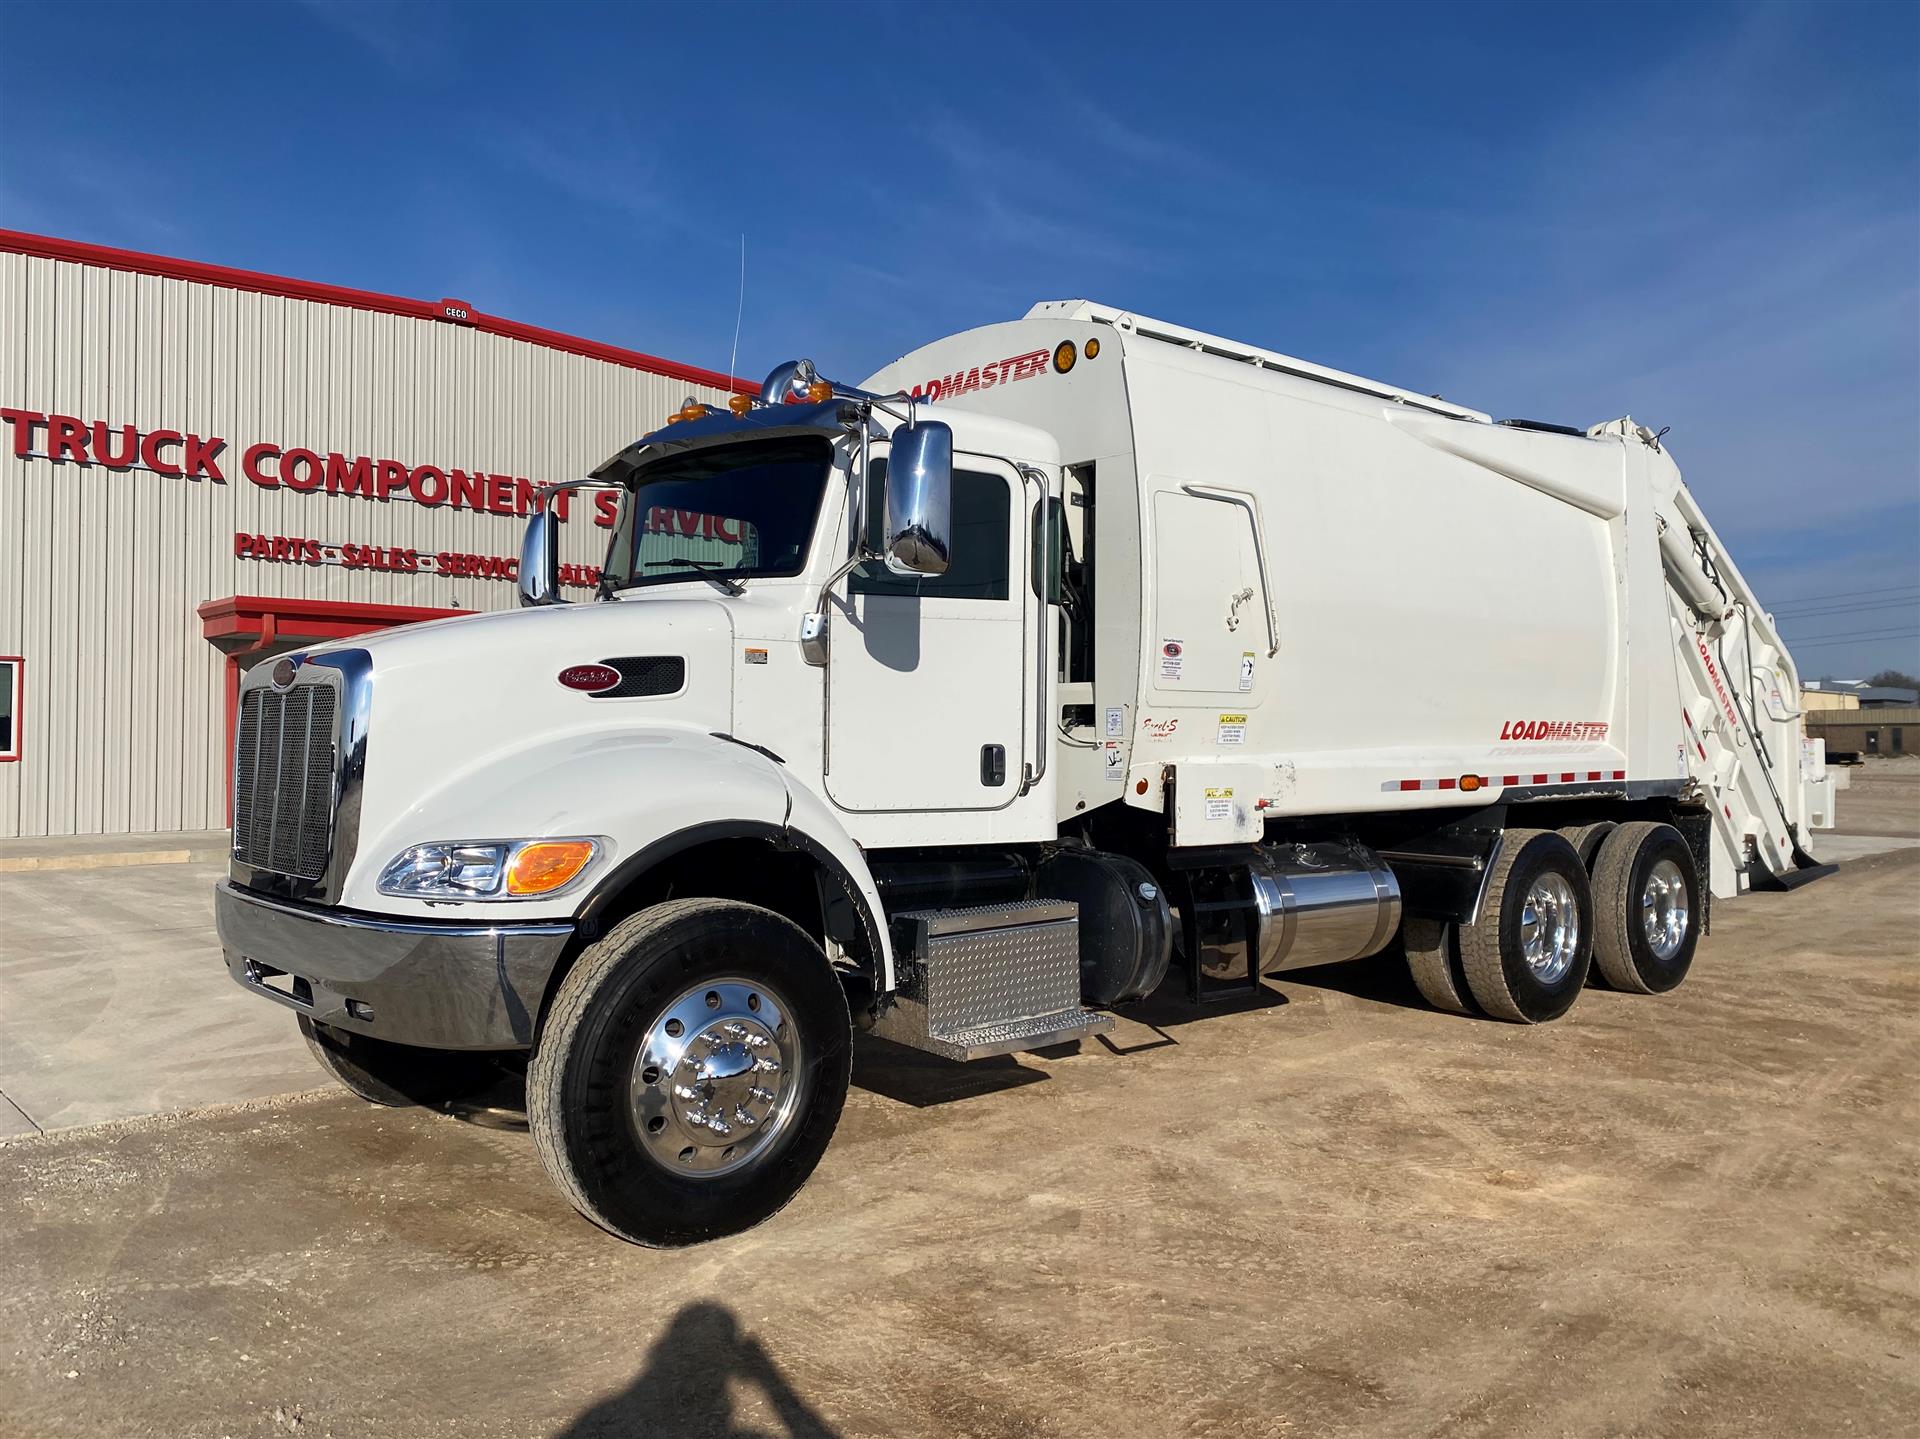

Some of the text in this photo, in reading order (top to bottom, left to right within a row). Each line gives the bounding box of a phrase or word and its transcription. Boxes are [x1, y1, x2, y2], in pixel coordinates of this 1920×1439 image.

[446, 307, 467, 319] CECO
[899, 348, 1050, 403] ADMASTER
[1, 408, 745, 543] TRUCK COMPONENT SRVIC
[235, 533, 321, 561] PARTS
[342, 543, 417, 571] SALES
[437, 552, 520, 581] SERVIC
[1500, 720, 1608, 741] LOADMASTER
